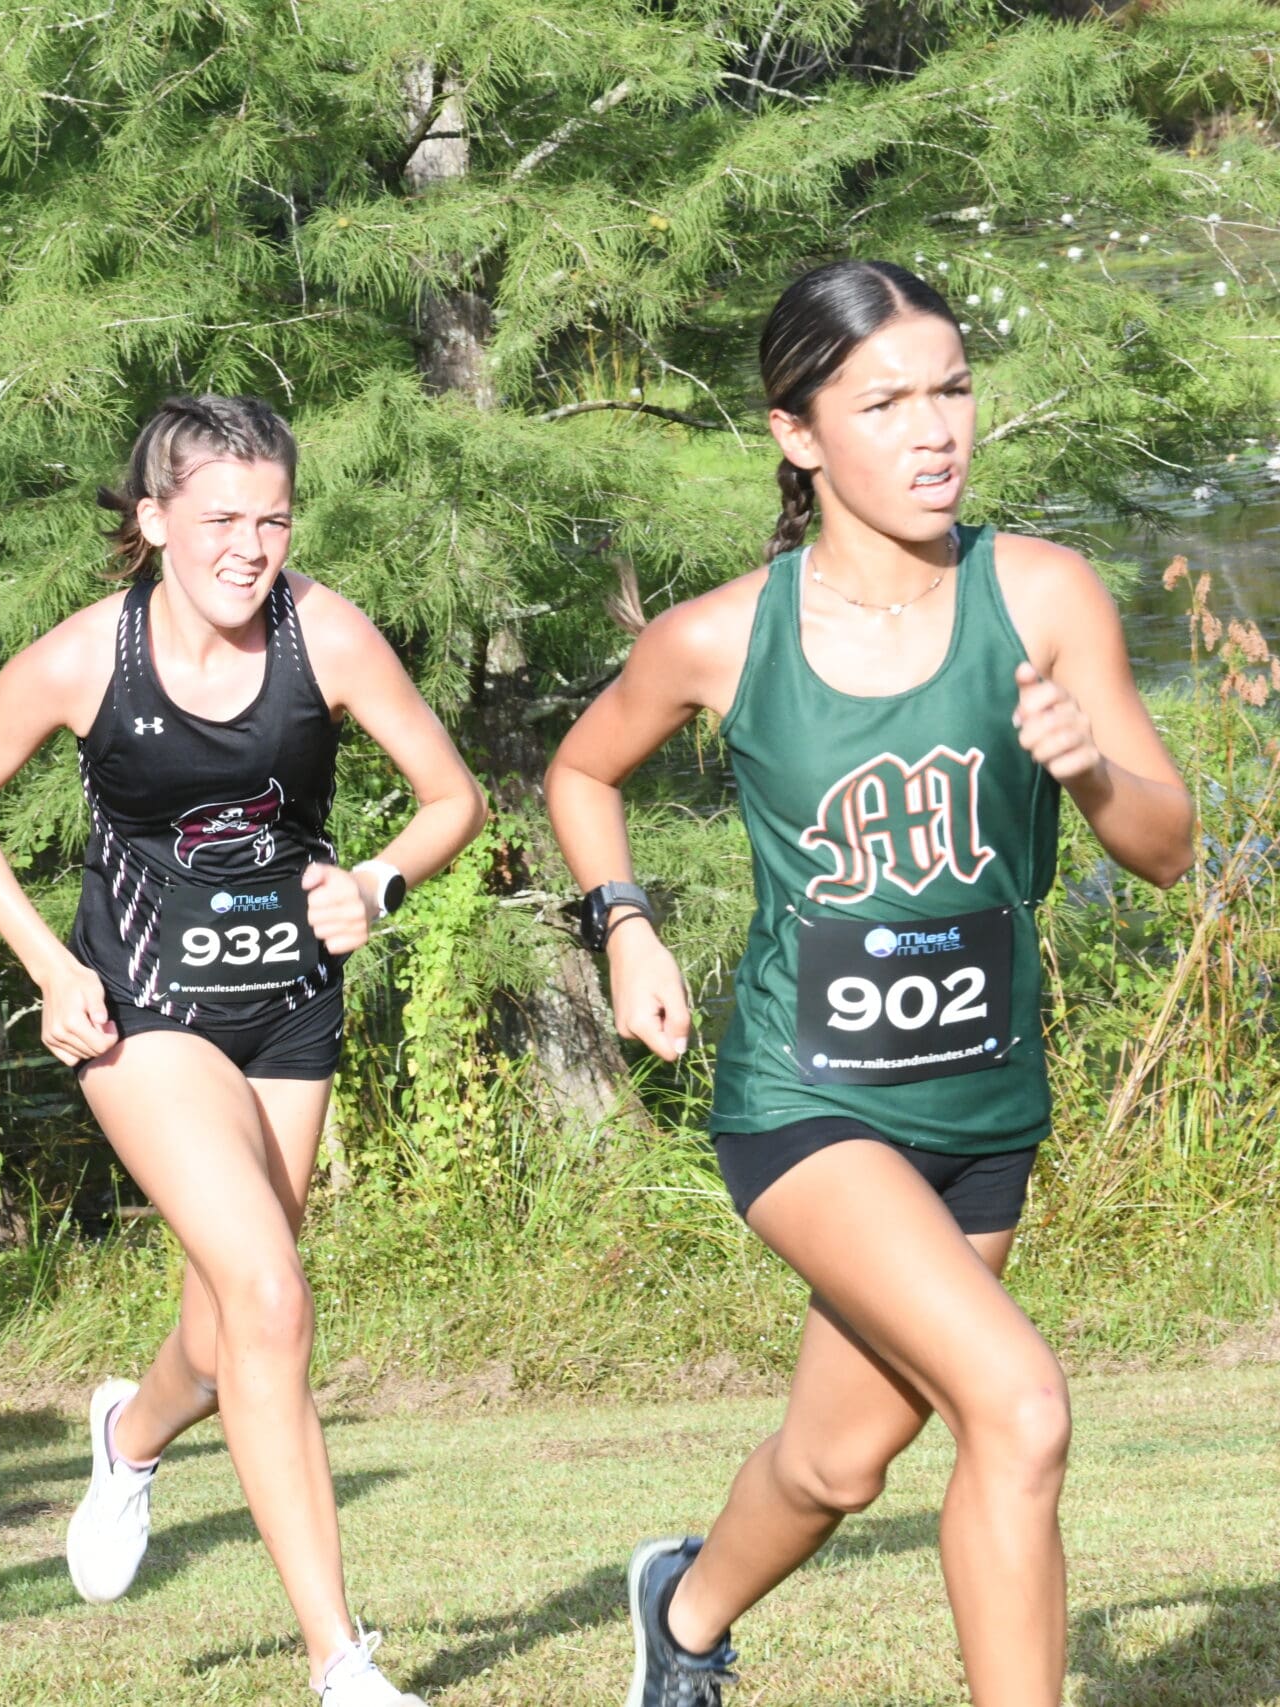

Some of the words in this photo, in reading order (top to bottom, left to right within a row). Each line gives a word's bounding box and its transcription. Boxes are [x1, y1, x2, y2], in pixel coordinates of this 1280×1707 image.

[181, 922, 300, 966] 932
[181, 979, 296, 993] www.milesandminutes.net
[827, 967, 987, 1031] 902
[828, 1044, 984, 1069] www.milesandminutes.net
